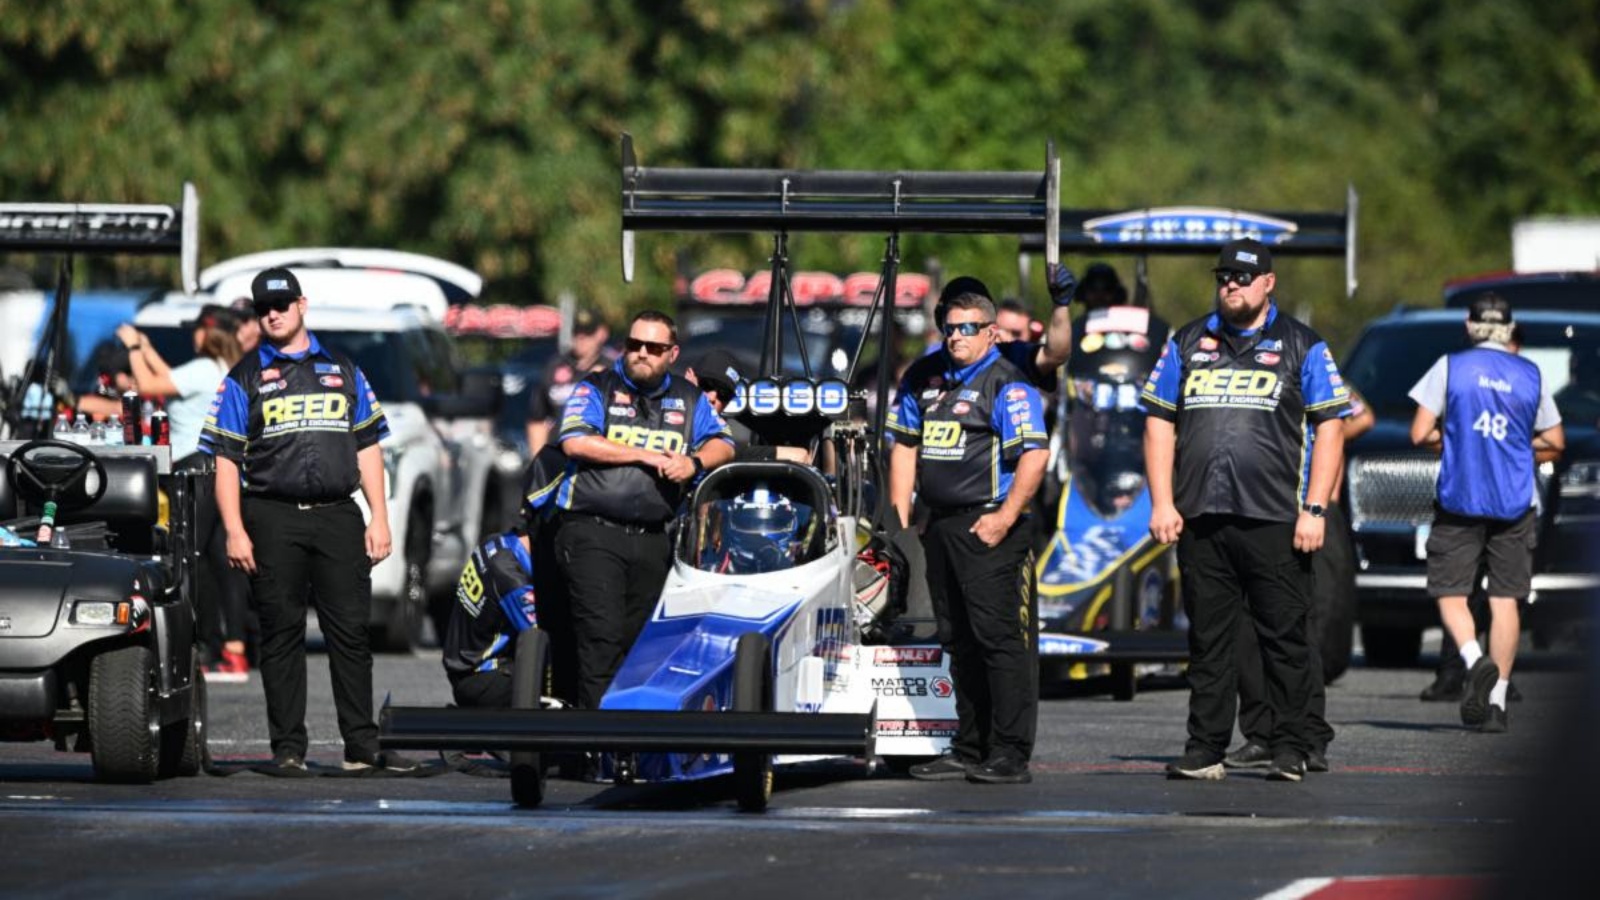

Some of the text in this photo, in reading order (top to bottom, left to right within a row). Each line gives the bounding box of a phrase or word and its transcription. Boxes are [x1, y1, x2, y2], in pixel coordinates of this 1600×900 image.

[1184, 369, 1277, 397] REED
[262, 392, 347, 427] REED
[923, 421, 961, 448] EED
[1473, 409, 1508, 441] 48
[607, 425, 684, 455] REED
[877, 649, 934, 660] MANLEY
[871, 678, 926, 687] MATCO
[871, 687, 927, 696] TOOLS
